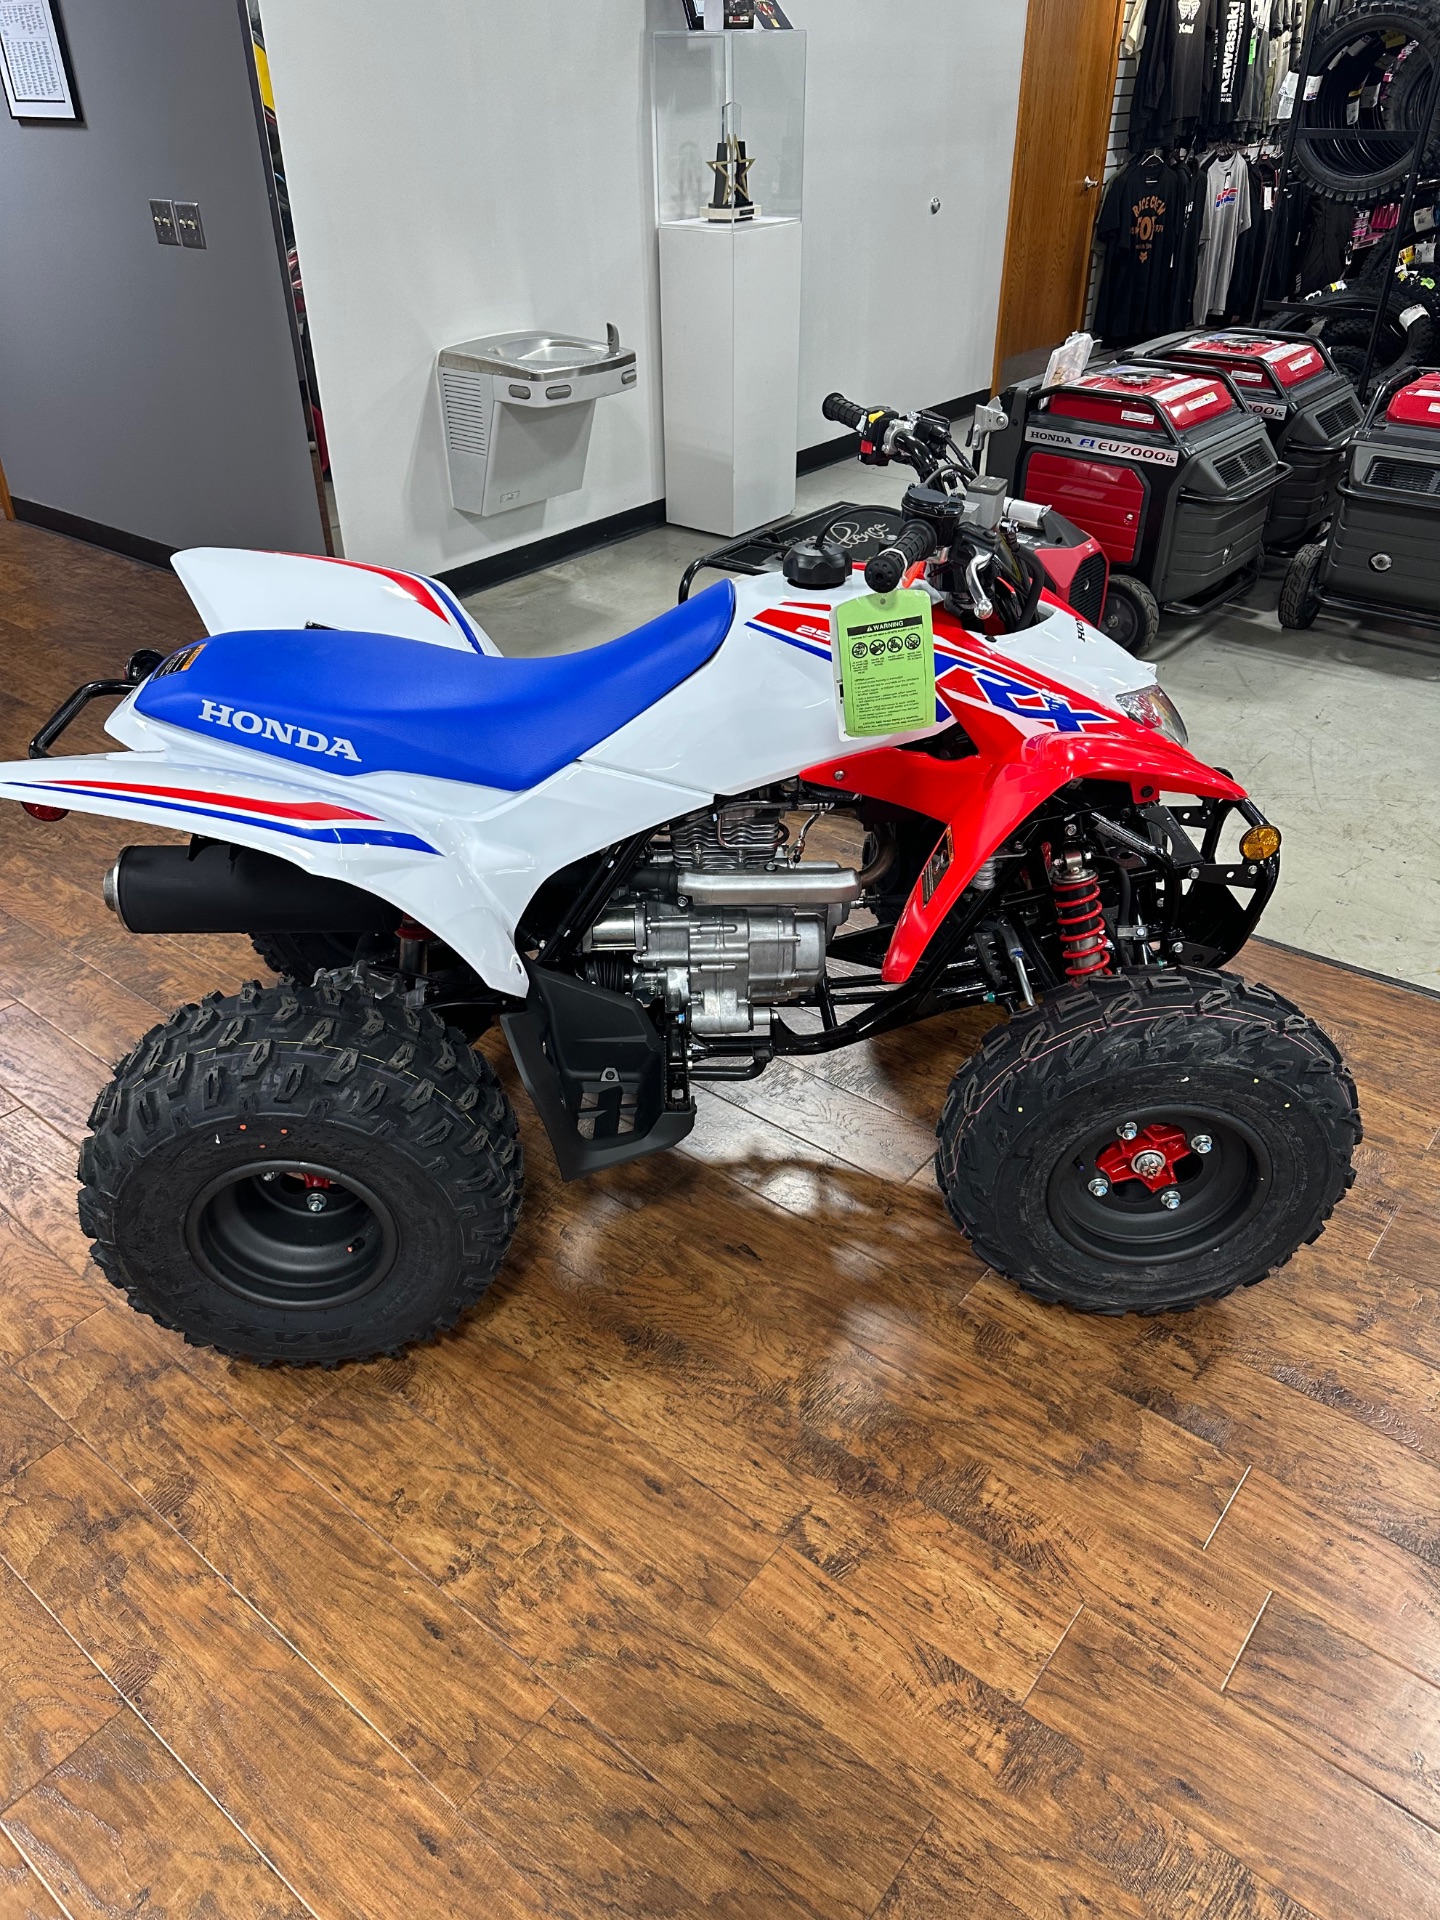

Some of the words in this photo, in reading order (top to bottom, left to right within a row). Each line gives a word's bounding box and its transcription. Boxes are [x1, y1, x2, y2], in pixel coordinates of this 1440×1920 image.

[1030, 430, 1073, 445] HONDA
[1097, 441, 1176, 464] EU7000is
[872, 620, 904, 632] WARNING
[197, 699, 363, 763] HONDA
